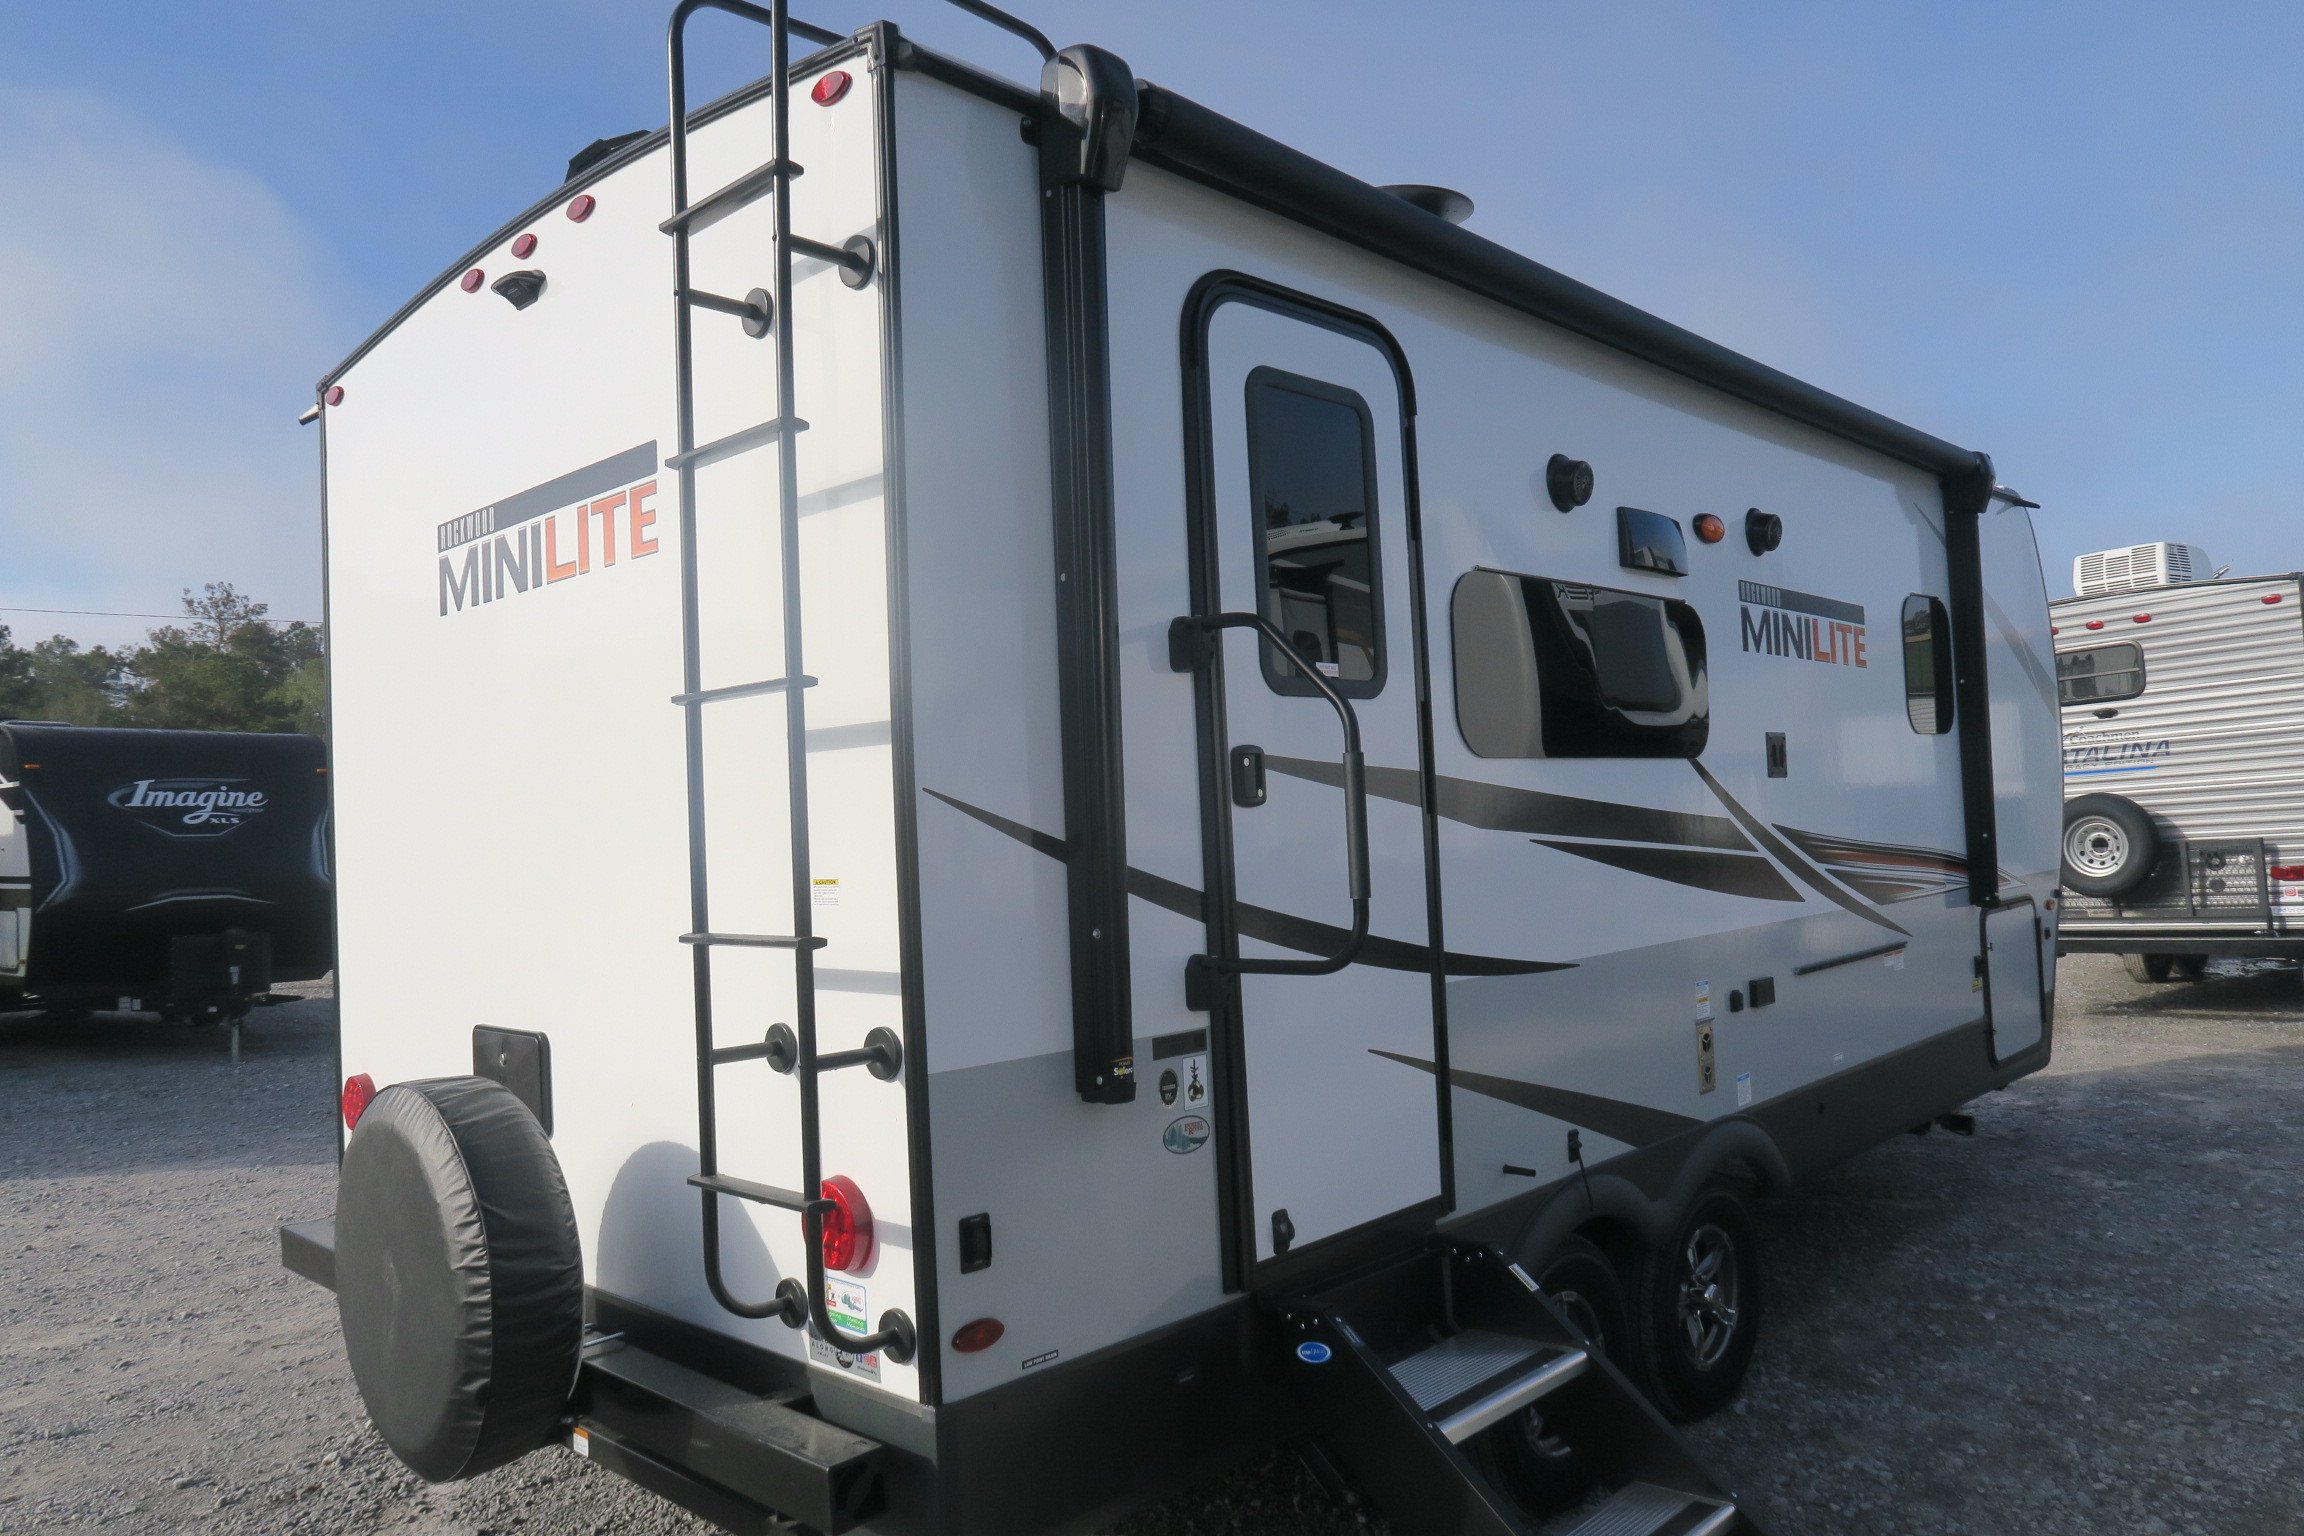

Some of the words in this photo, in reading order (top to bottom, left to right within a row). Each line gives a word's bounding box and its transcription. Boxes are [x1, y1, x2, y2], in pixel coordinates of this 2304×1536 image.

[439, 479, 659, 617] MINILITE
[440, 506, 495, 550] ROCKWOOD
[1740, 605, 1867, 668] MINILITE
[2063, 740, 2171, 764] TALINA
[124, 779, 270, 825] Imagine
